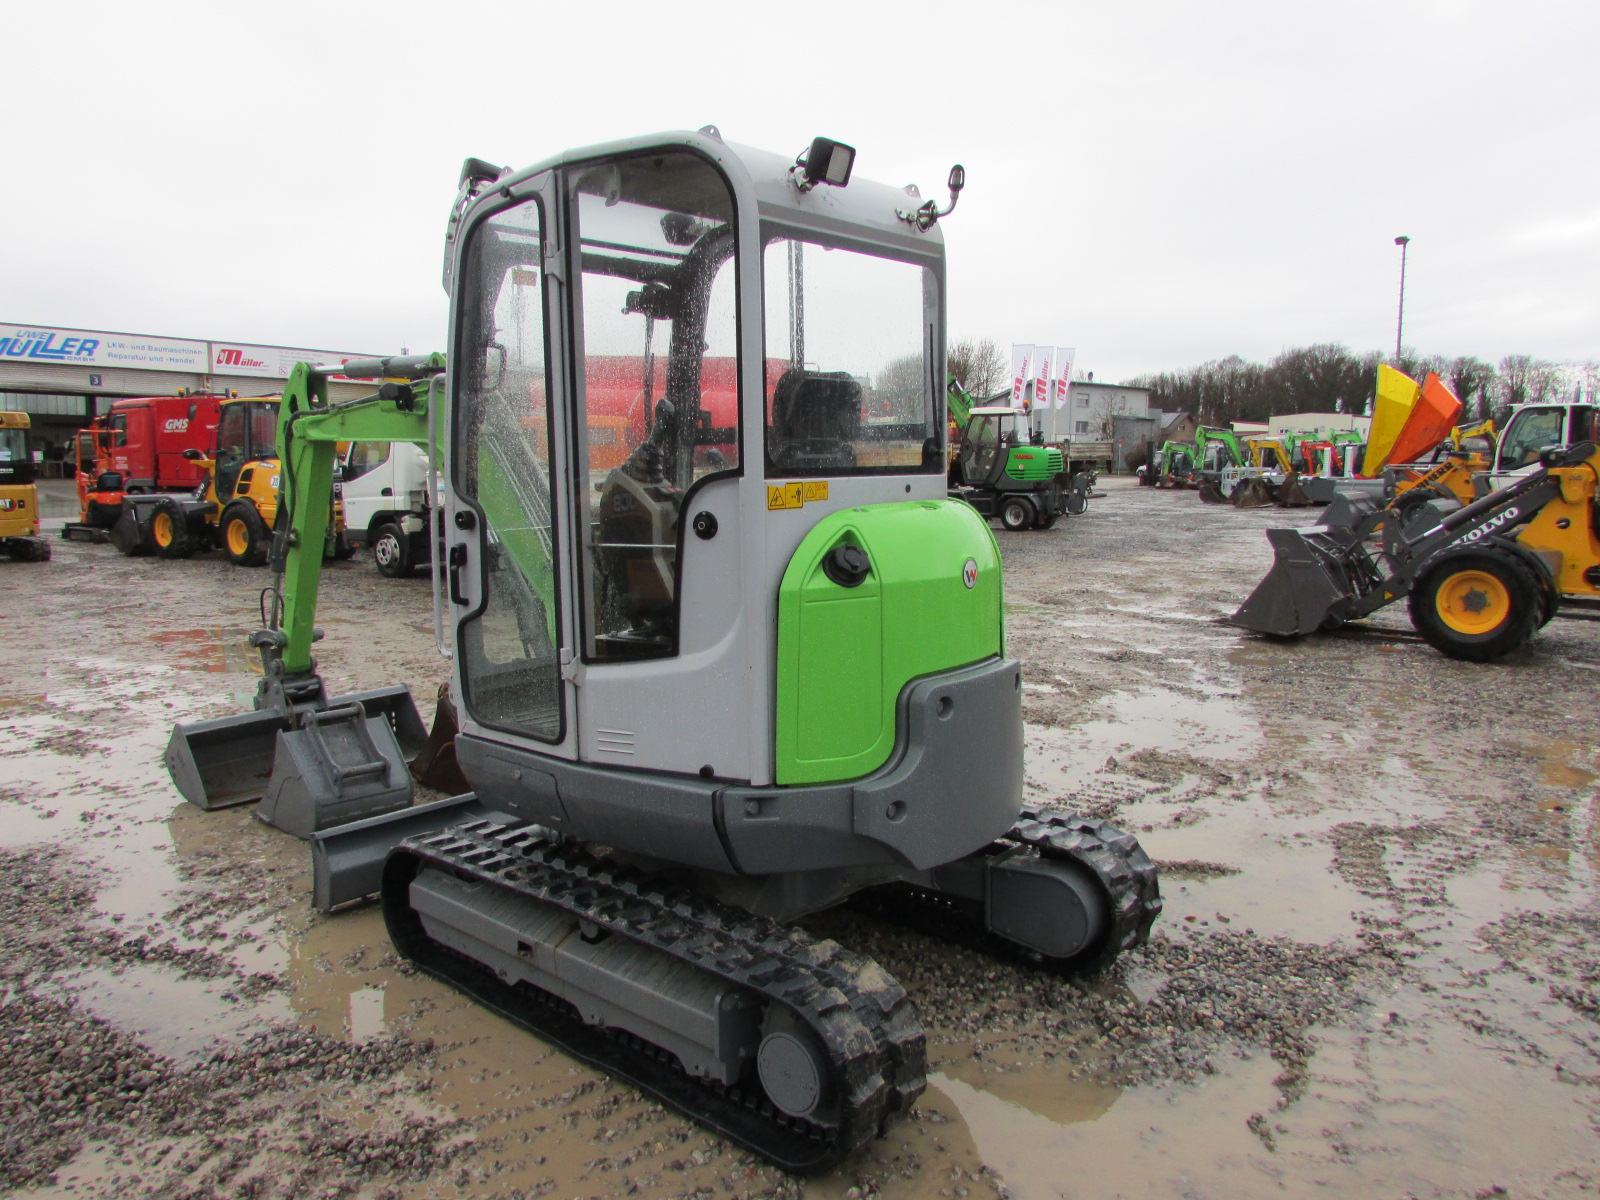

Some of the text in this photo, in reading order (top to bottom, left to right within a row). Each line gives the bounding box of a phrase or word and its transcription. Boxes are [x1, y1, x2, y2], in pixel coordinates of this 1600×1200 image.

[17, 330, 48, 340] UWE
[147, 345, 206, 356] Baumaschinen-
[107, 352, 147, 361] Reparatur
[93, 376, 99, 385] 3
[165, 418, 189, 430] GMS
[0, 498, 11, 510] AT
[1451, 507, 1520, 546] VOLVO
